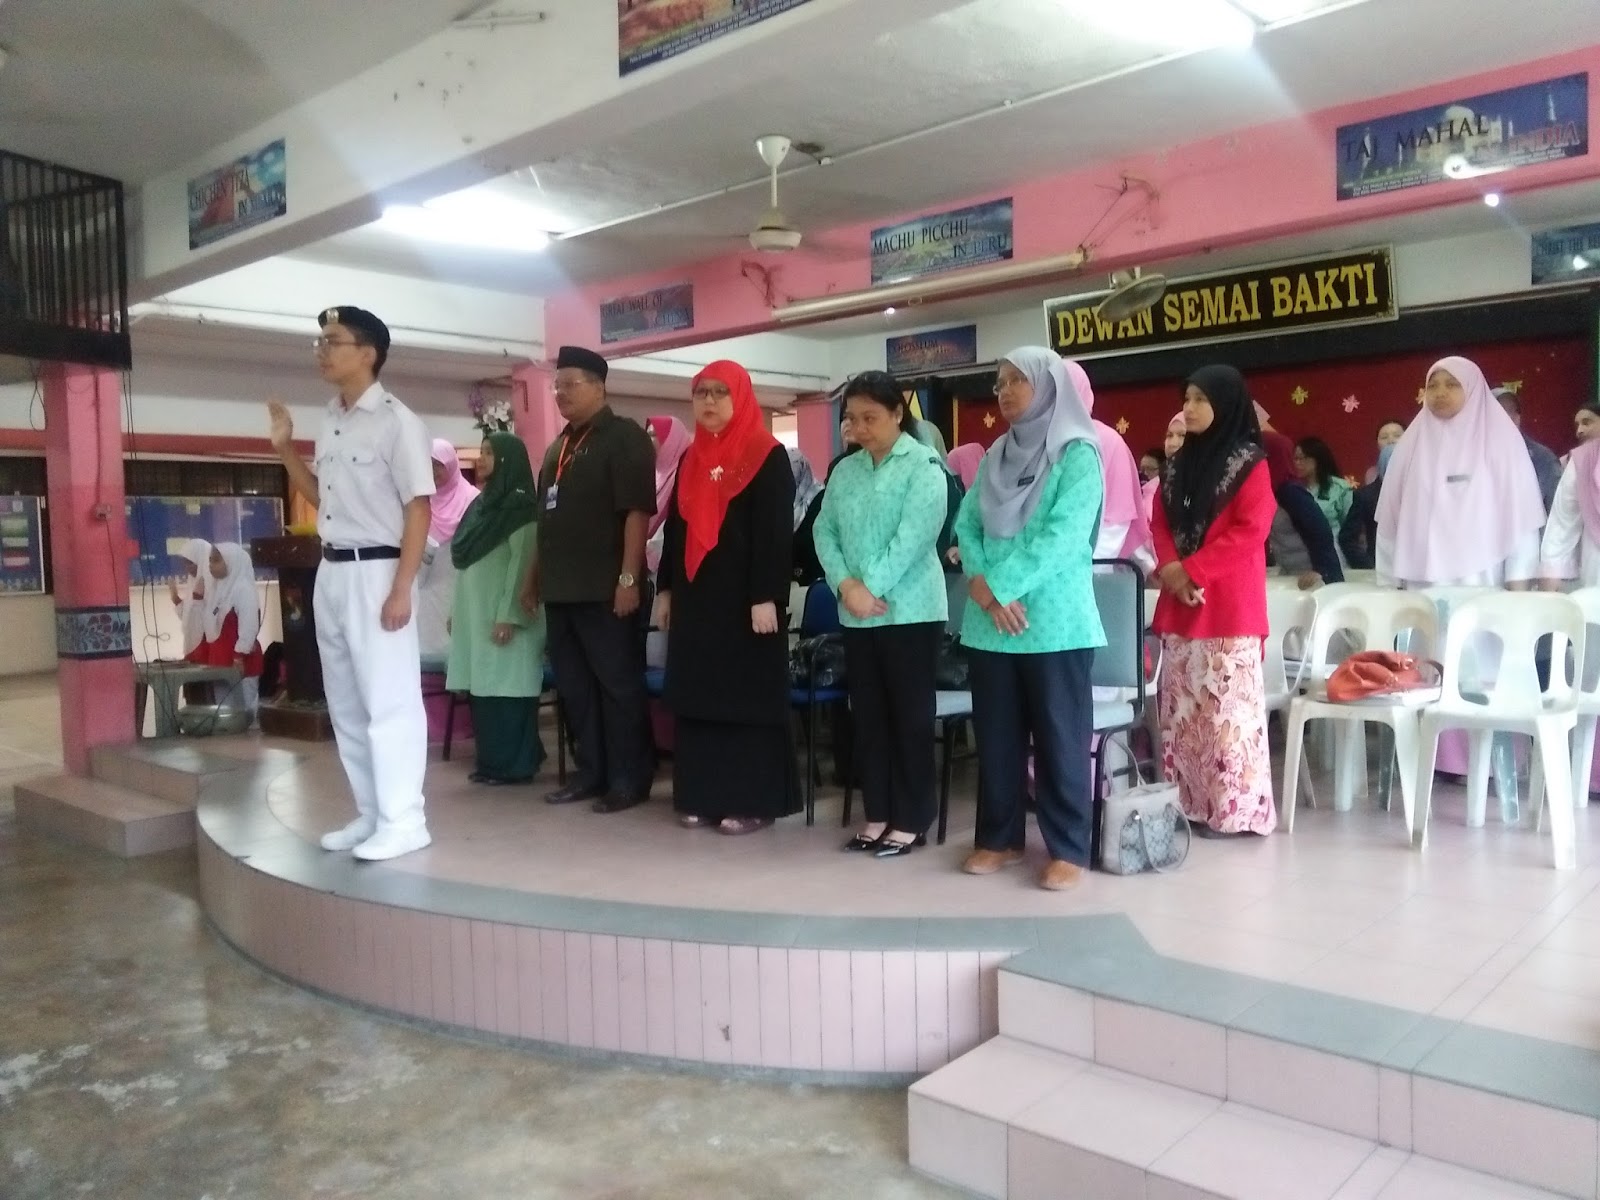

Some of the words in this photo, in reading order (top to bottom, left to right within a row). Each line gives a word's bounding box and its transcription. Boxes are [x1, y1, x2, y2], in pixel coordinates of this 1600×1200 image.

[1341, 135, 1377, 162] TAJ
[1395, 113, 1489, 151] MAHAL
[873, 230, 915, 255] MACHU
[921, 218, 968, 244] PICCHU
[953, 244, 967, 258] IN
[974, 233, 1008, 254] PERU
[1056, 305, 1153, 348] DEWAN
[1164, 281, 1262, 333] SEMAI
[1271, 262, 1378, 318] BAKTI
